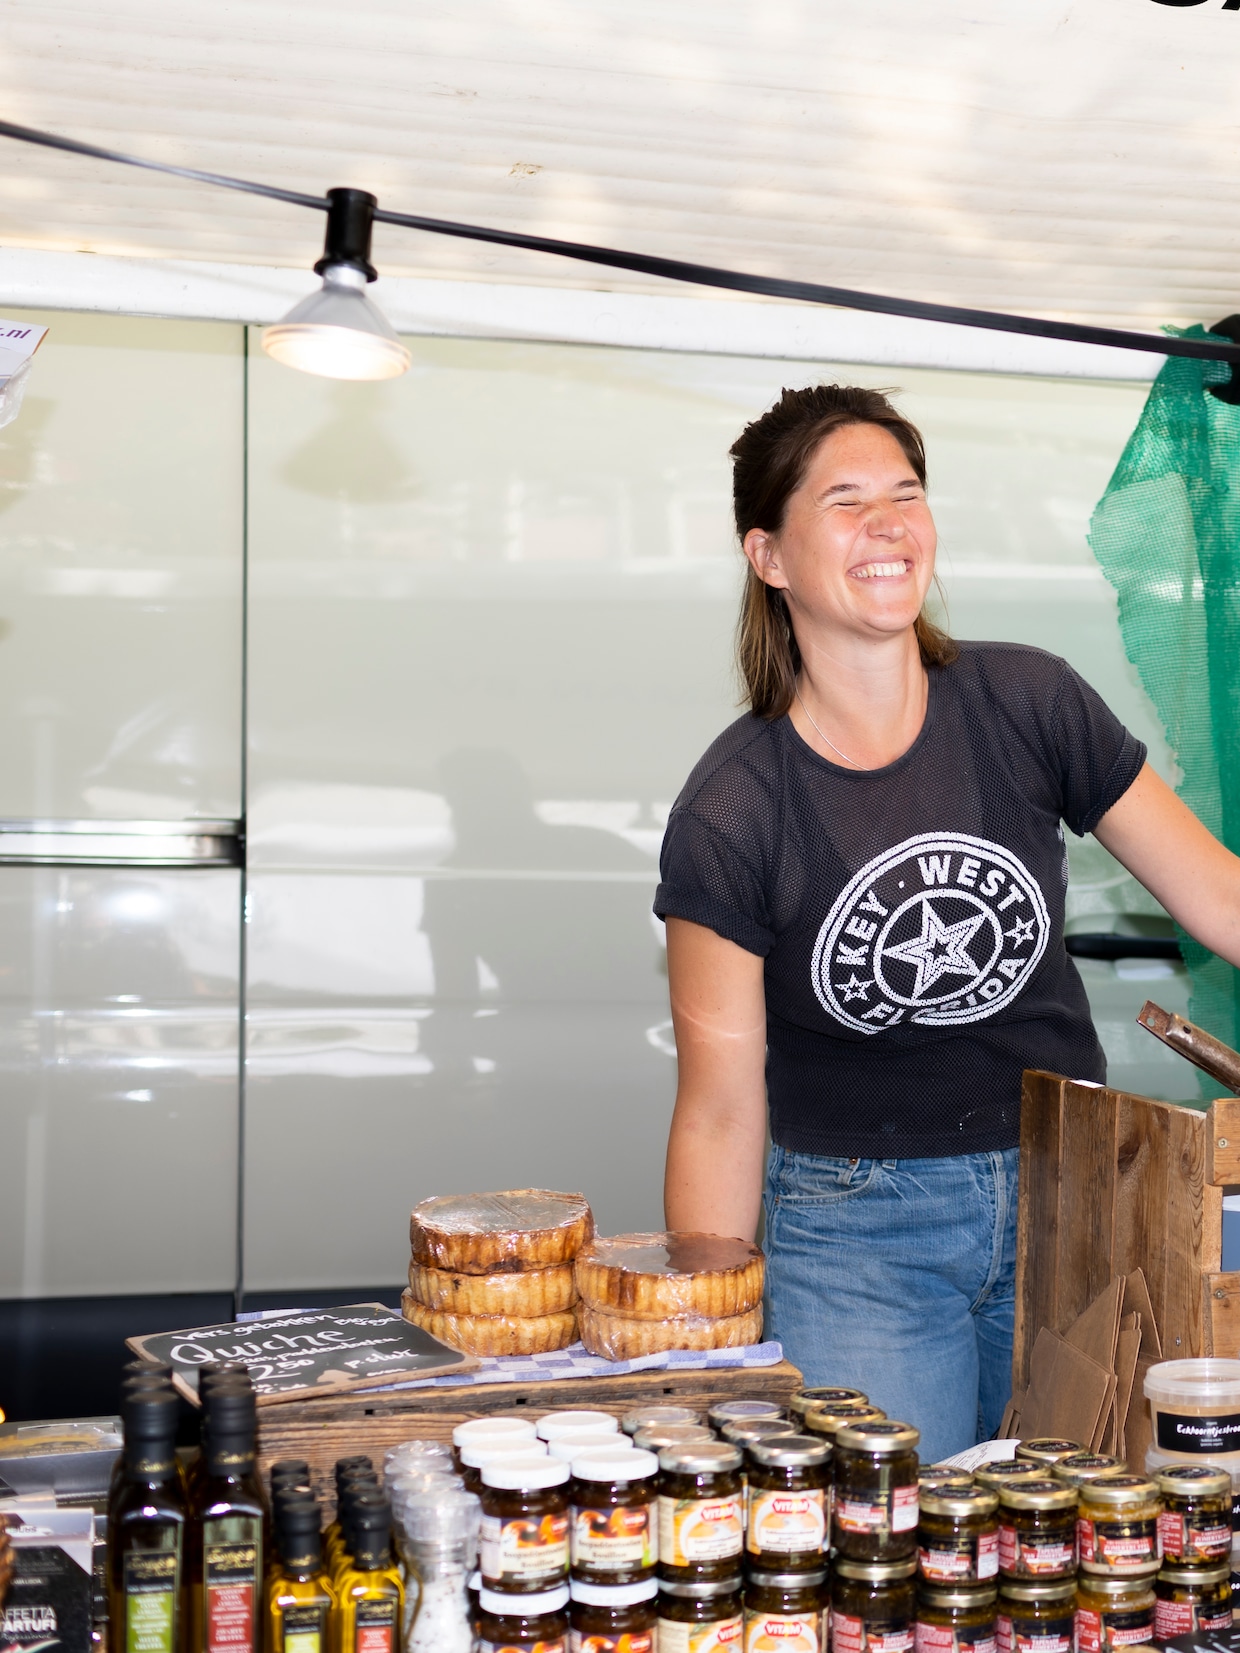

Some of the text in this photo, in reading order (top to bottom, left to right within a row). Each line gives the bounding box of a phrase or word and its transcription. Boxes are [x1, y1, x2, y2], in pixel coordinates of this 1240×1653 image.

[836, 855, 1026, 966] KEY WEST
[860, 957, 1028, 1026] FLRIDA
[170, 1330, 356, 1364] Quiche
[702, 1505, 736, 1520] VITAM
[774, 1500, 809, 1513] VITAM
[766, 1623, 801, 1635] VITAM
